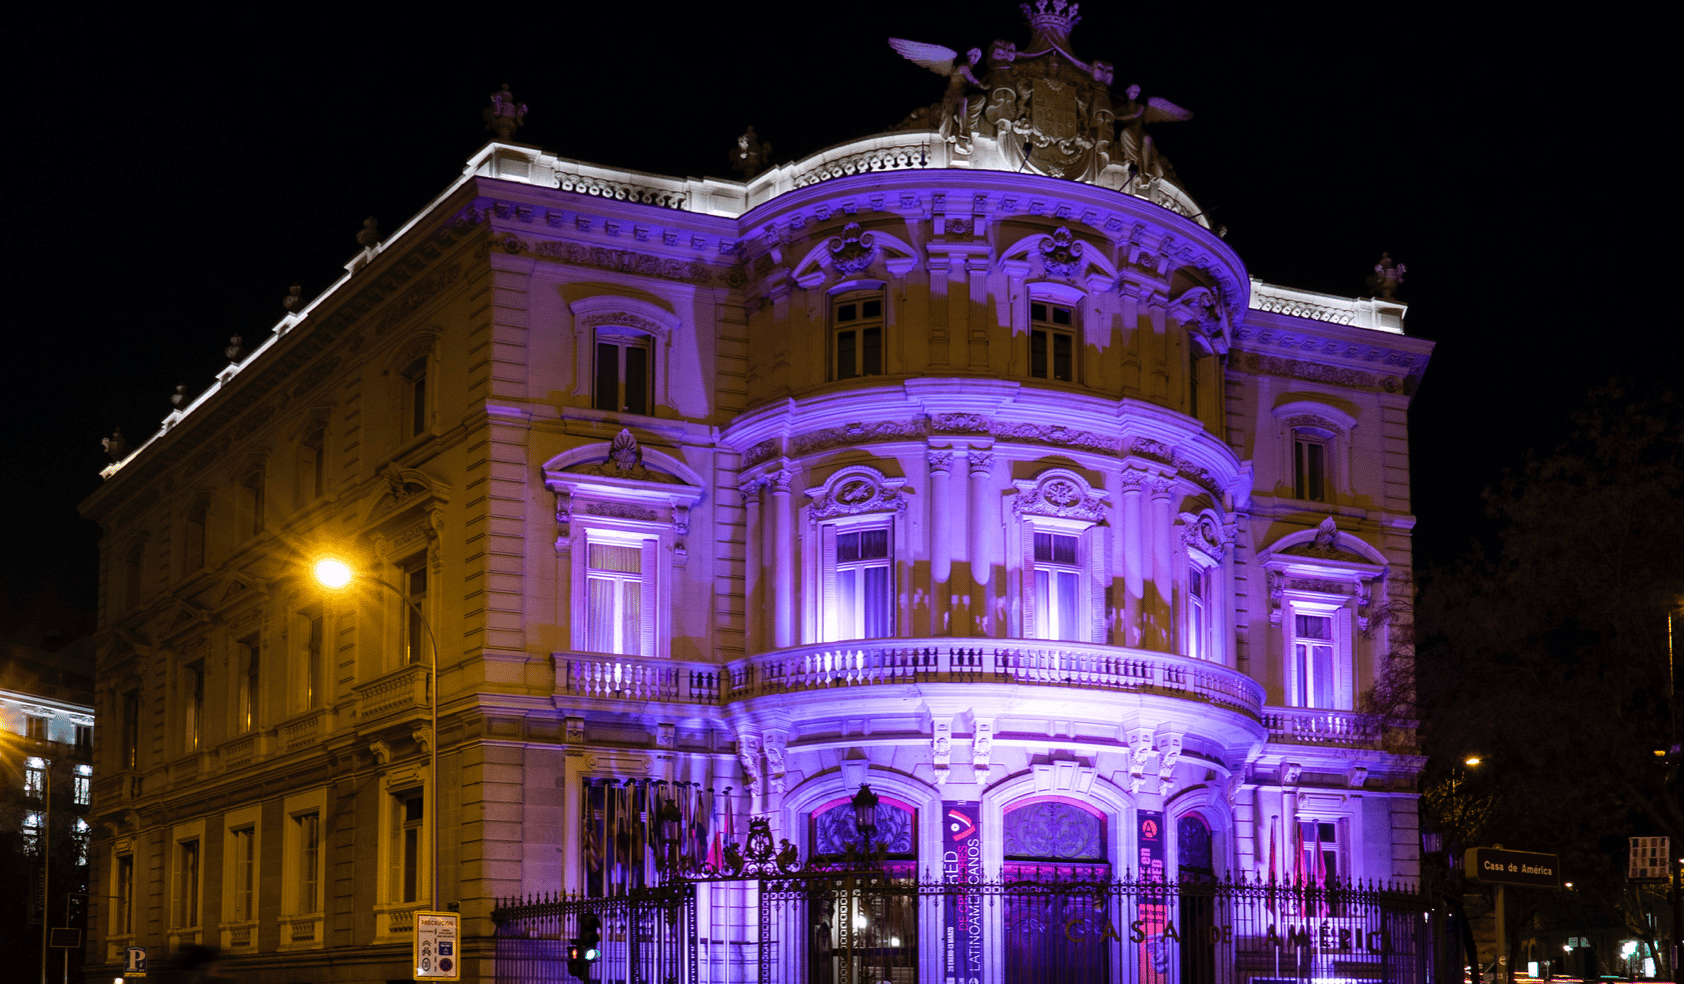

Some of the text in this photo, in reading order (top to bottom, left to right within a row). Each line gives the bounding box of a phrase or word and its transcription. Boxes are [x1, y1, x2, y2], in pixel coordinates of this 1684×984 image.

[1140, 847, 1150, 865] en
[1151, 859, 1163, 884] RED
[1483, 860, 1553, 876] Casa de América
[968, 838, 981, 972] LATINOAMERCANOS
[958, 916, 968, 931] DE
[1065, 919, 1392, 953] CASA DE AMÉRICA
[126, 949, 146, 971] P
